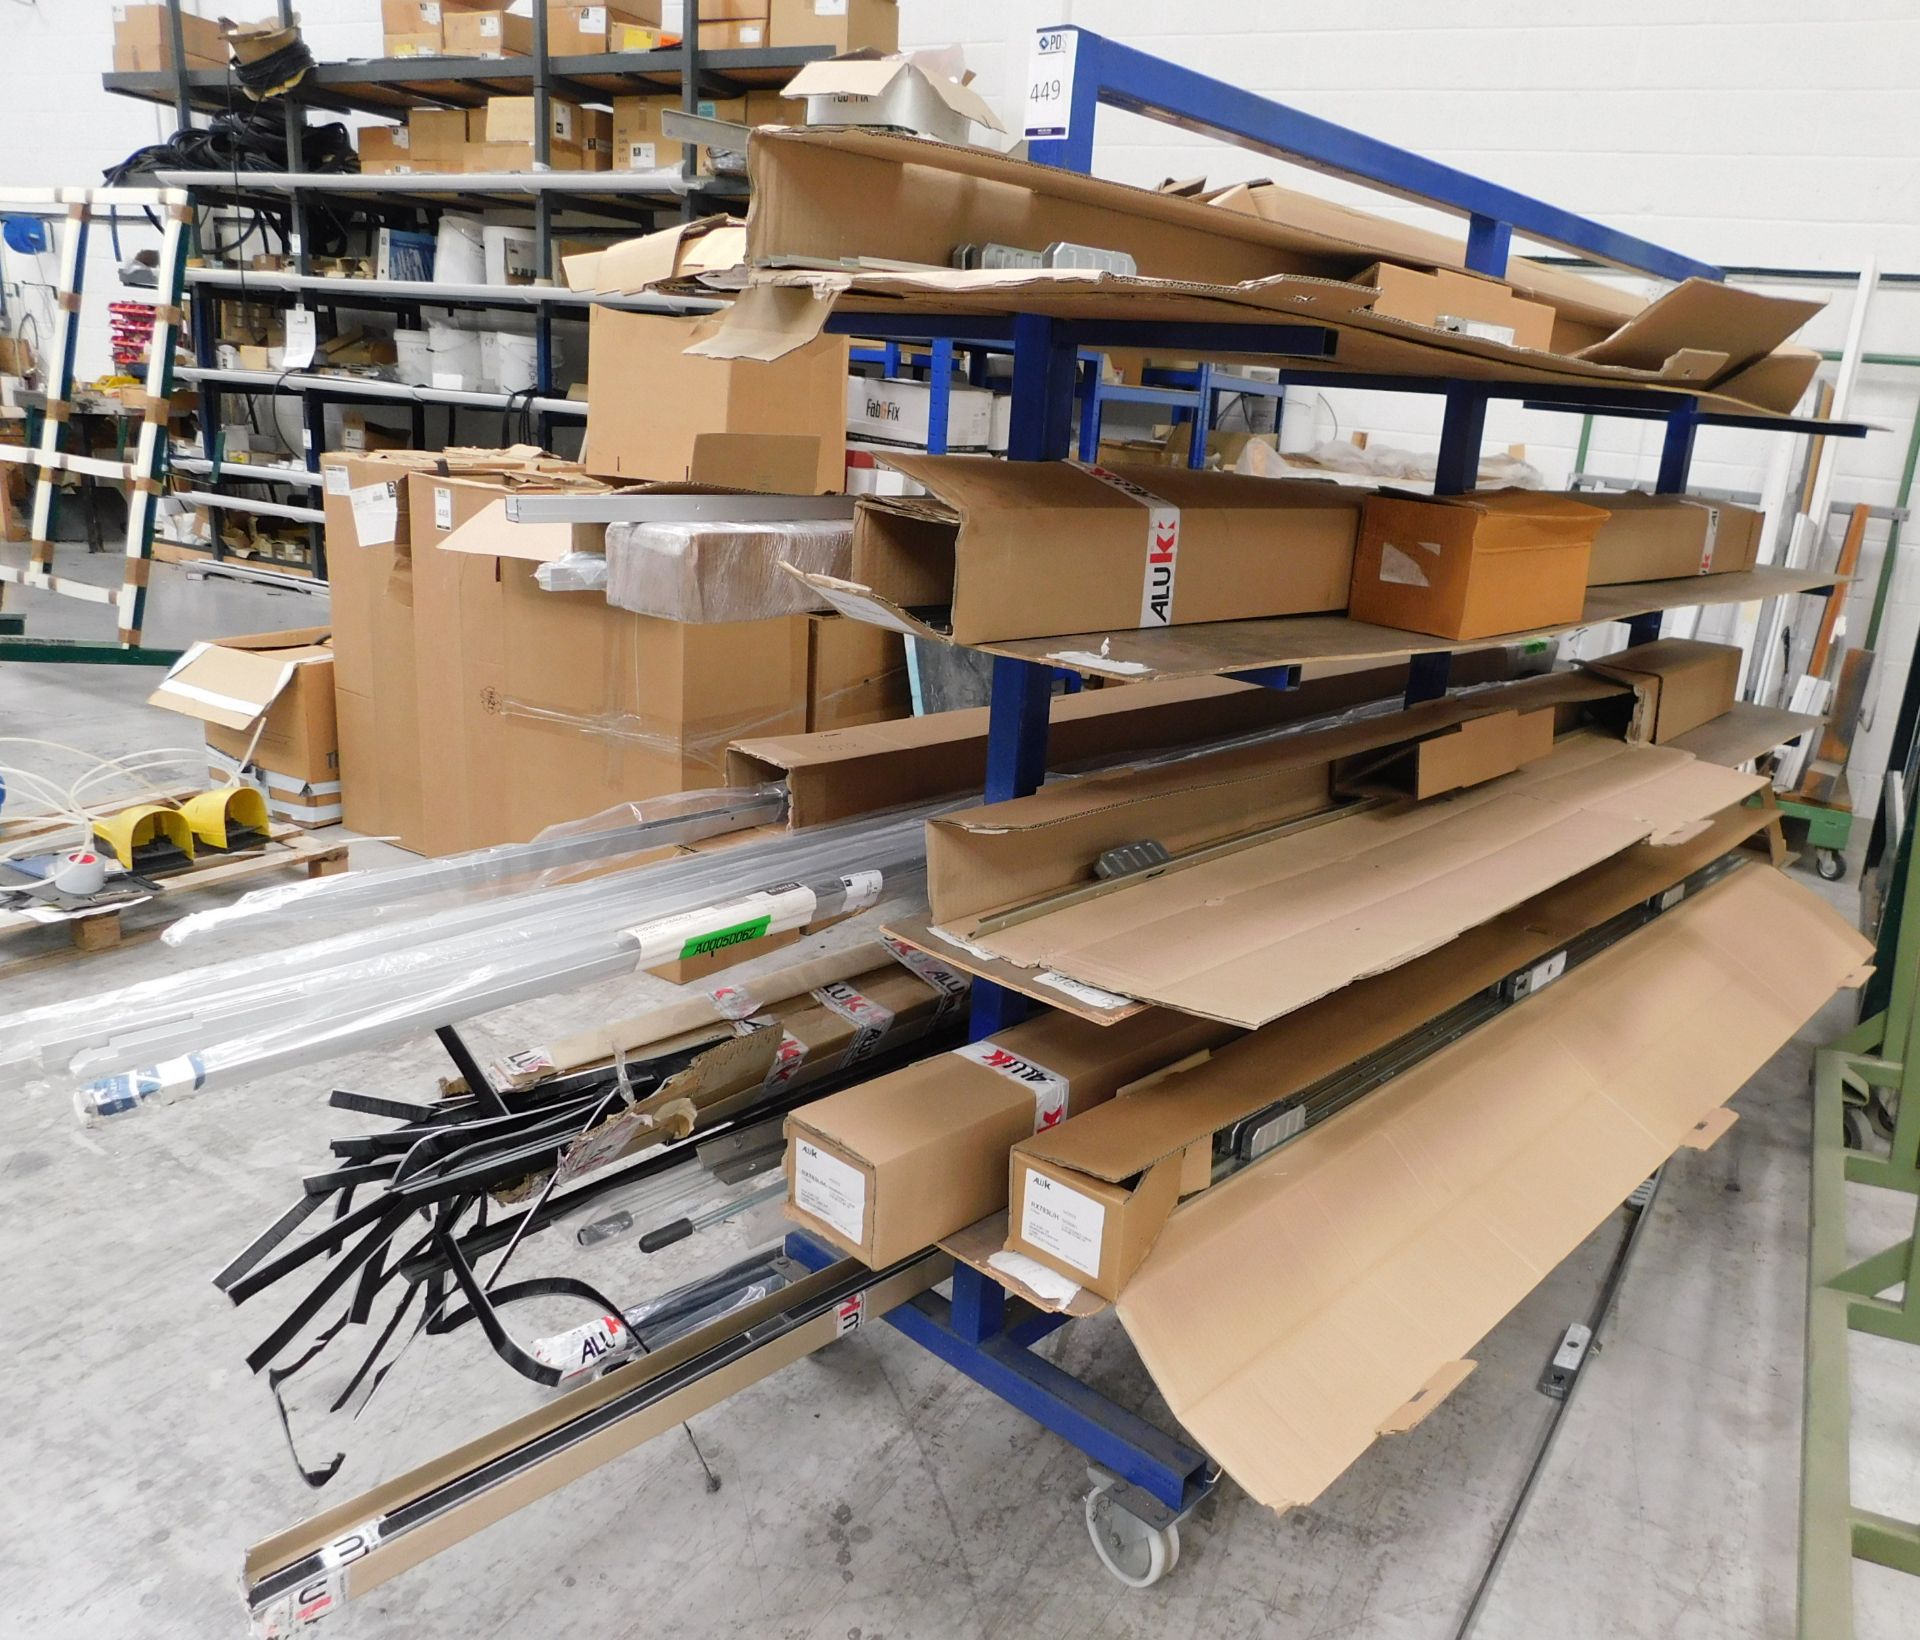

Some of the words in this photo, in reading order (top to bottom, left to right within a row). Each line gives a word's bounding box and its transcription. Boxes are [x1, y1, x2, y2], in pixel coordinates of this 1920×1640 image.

[1030, 79, 1061, 103] 449
[1150, 533, 1176, 624] ALUK
[694, 926, 757, 955] A00050062
[981, 1049, 1057, 1082] ALUK
